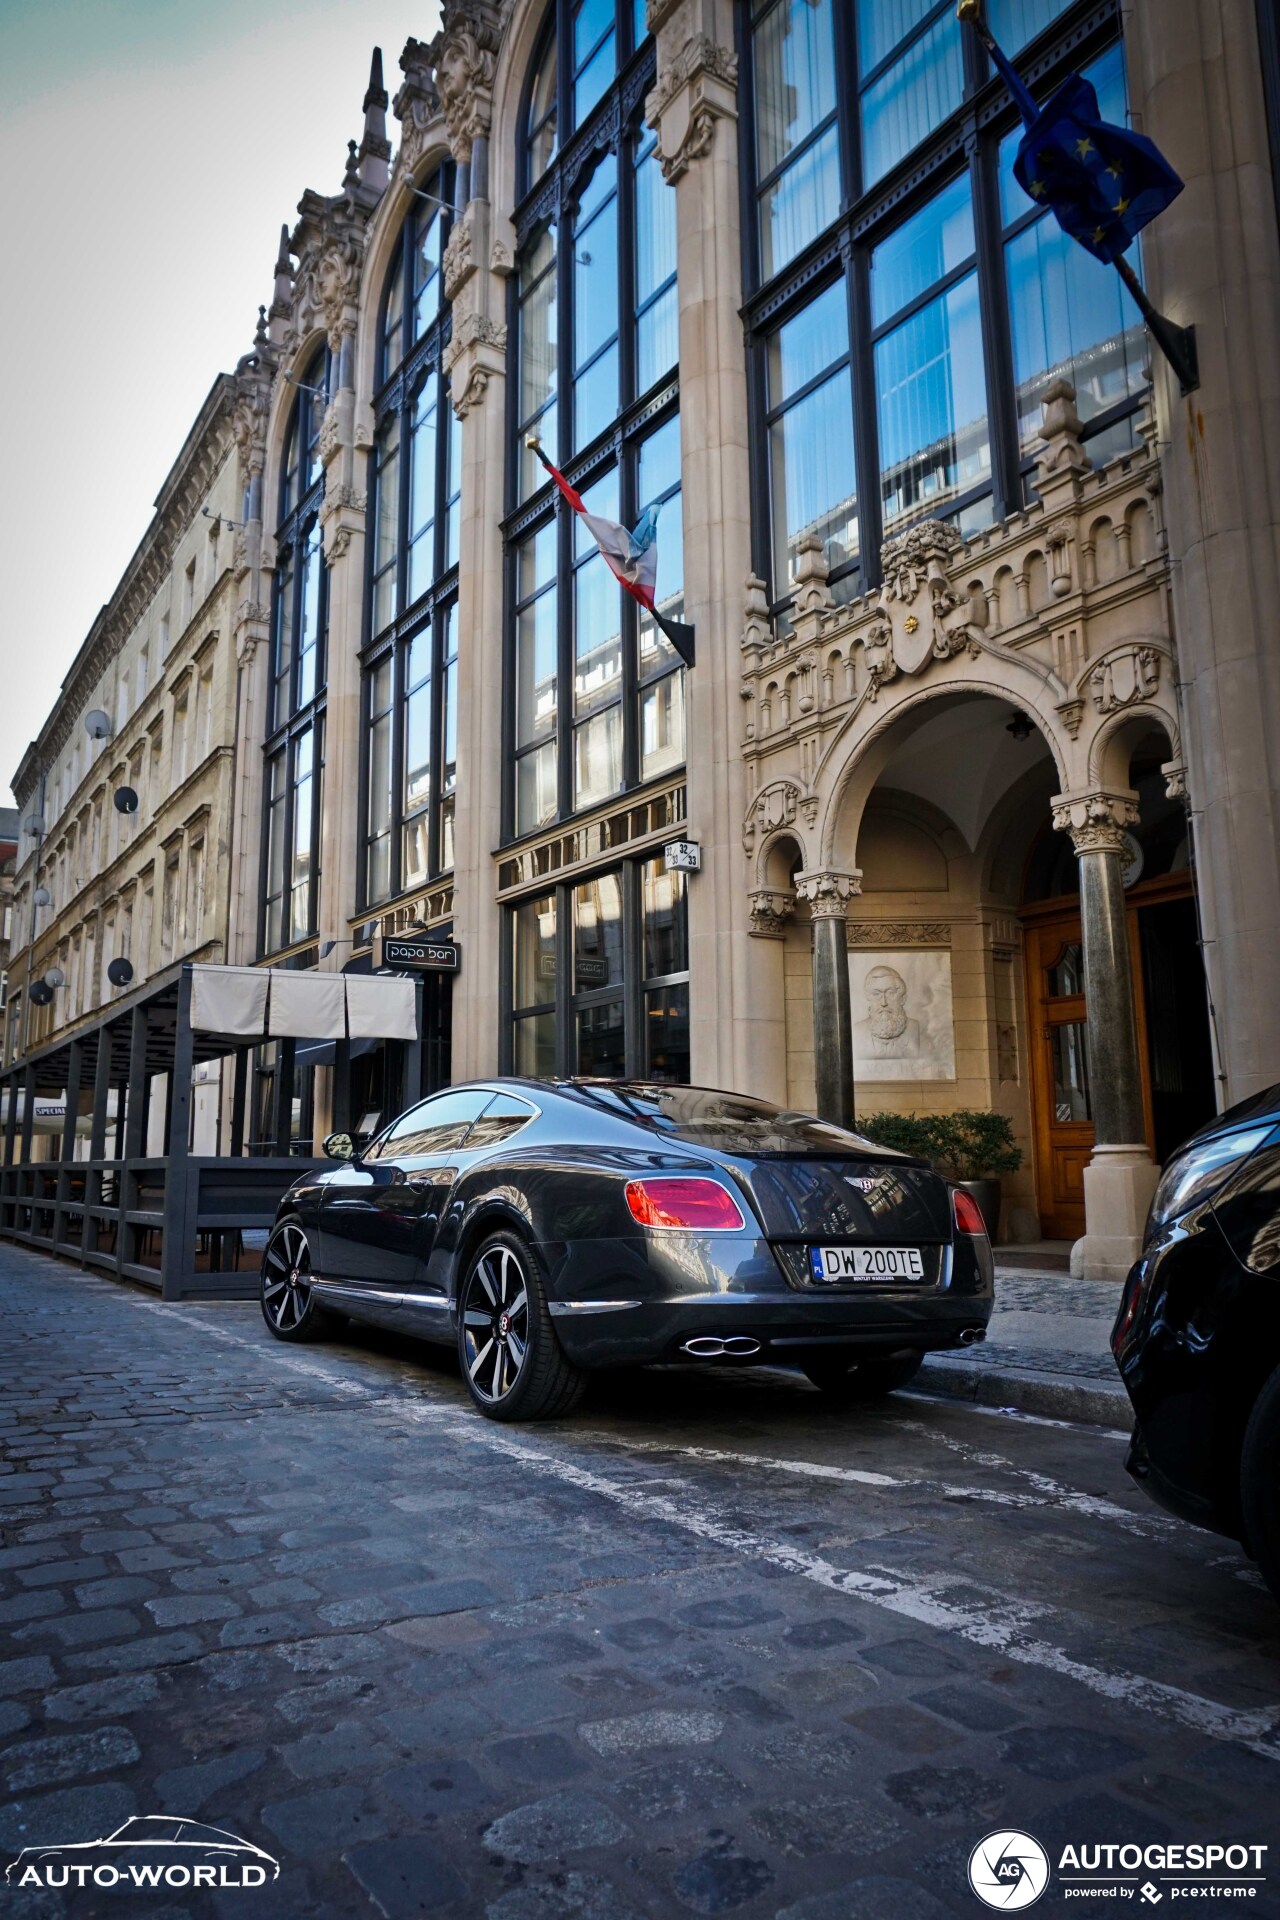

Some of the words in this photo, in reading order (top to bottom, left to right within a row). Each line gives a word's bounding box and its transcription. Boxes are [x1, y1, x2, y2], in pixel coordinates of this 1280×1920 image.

[391, 946, 424, 959] papa
[428, 947, 452, 959] bar
[825, 1249, 856, 1275] DW
[862, 1249, 921, 1274] 200TE
[814, 1266, 823, 1274] PL
